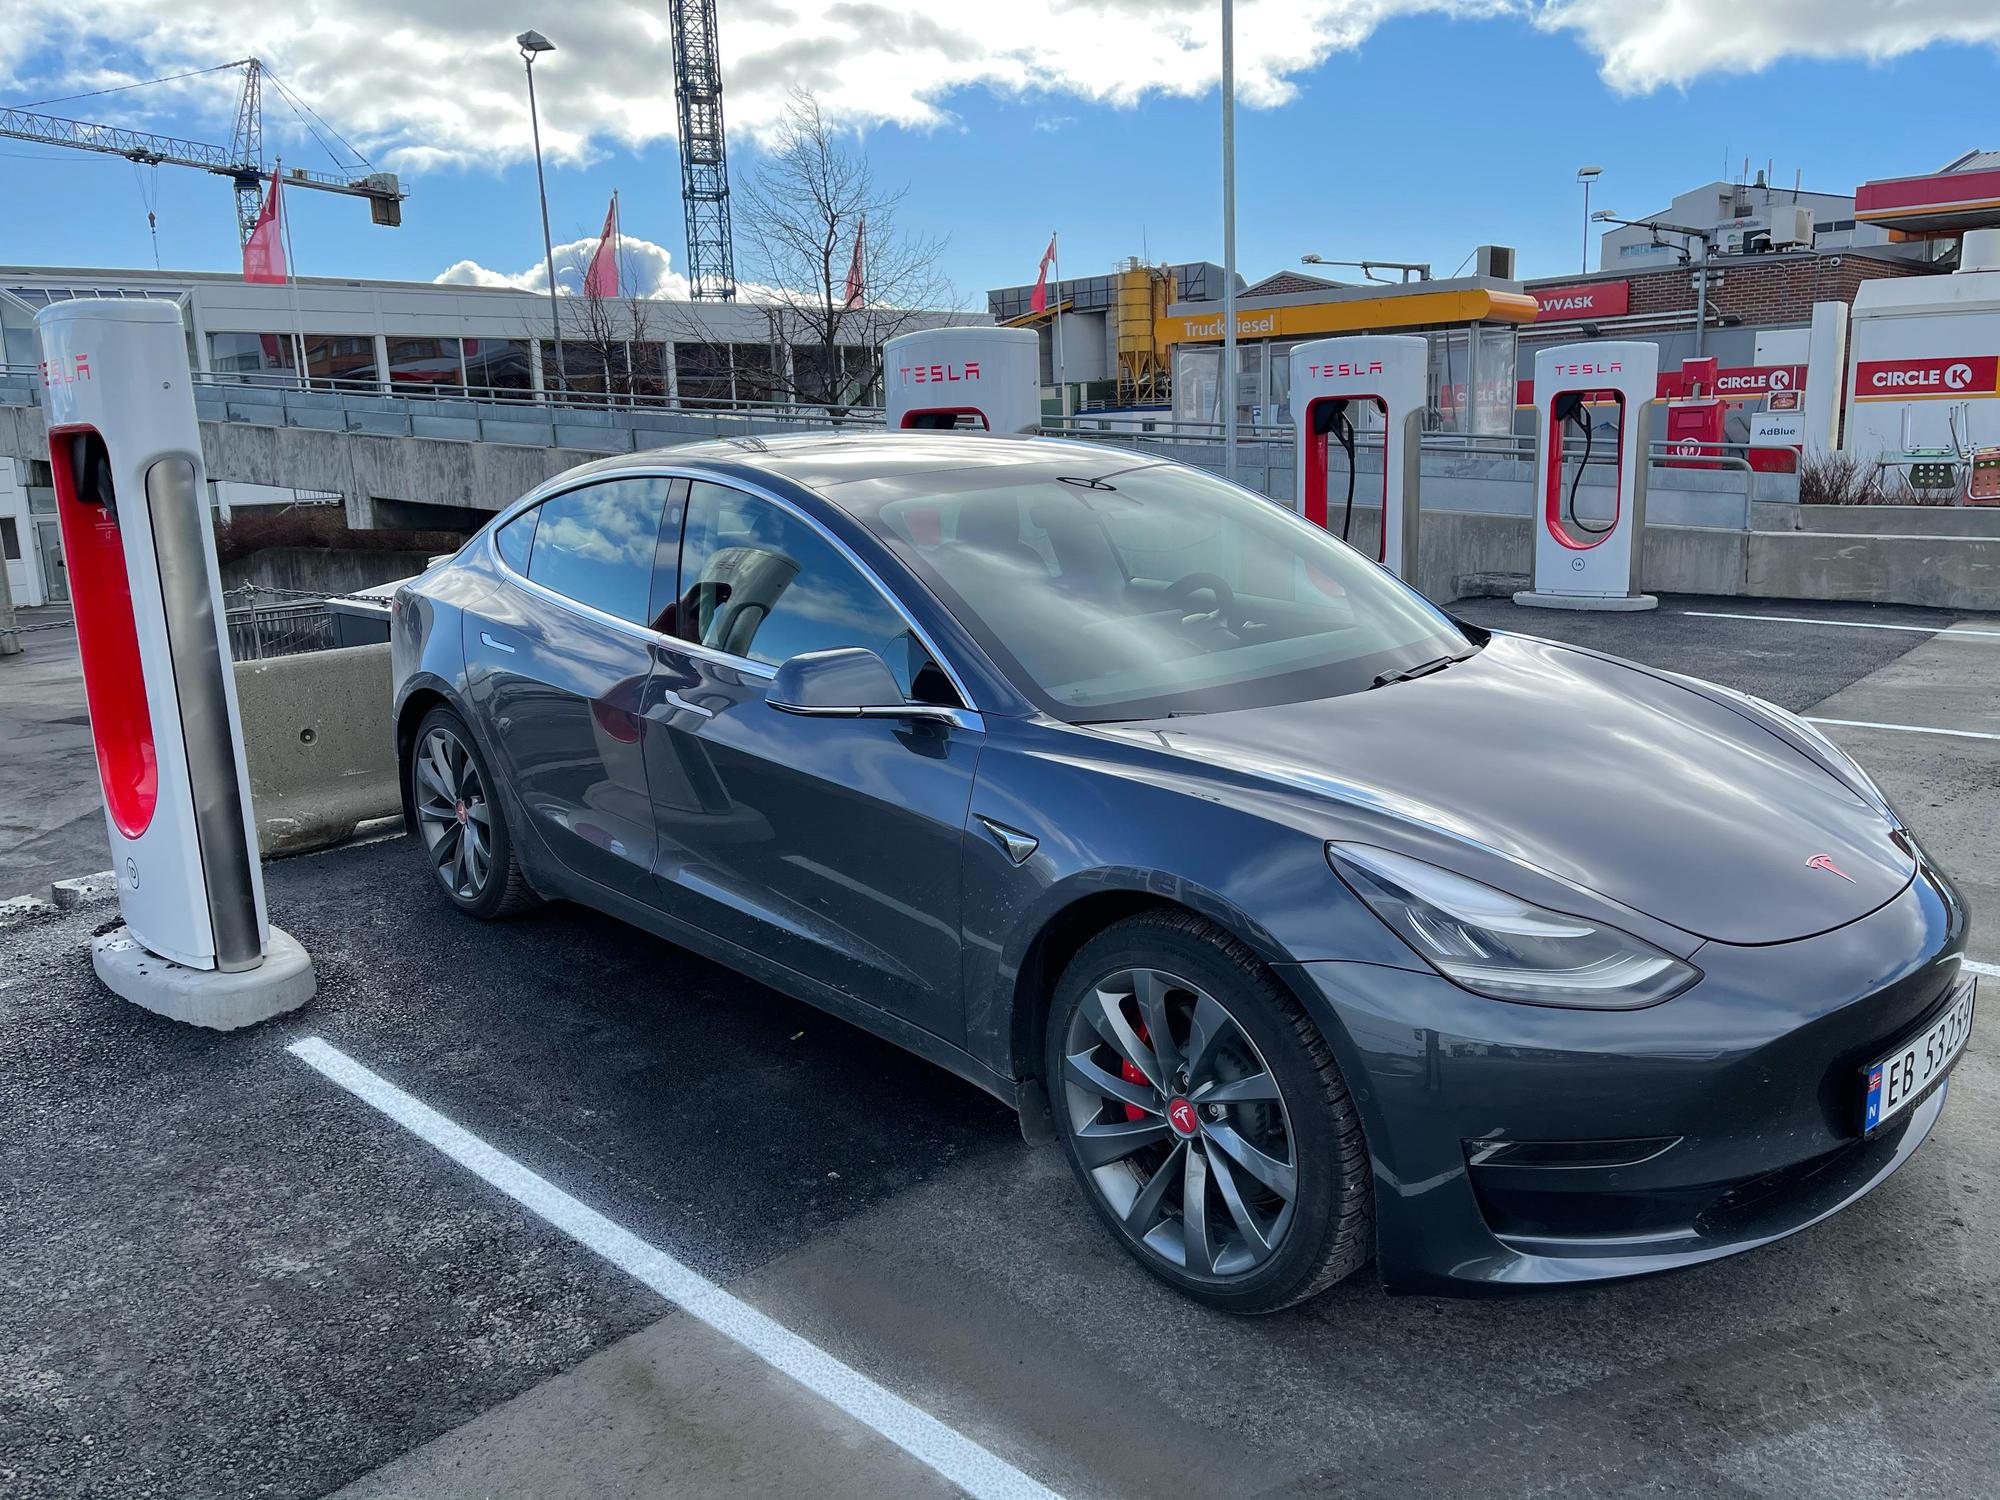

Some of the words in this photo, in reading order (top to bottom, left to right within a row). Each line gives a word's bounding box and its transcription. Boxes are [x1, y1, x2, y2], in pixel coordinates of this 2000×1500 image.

[1184, 313, 1274, 336] Truckiesel
[900, 362, 980, 385] TESLA
[1309, 362, 1382, 378] TESLA
[1555, 363, 1621, 375] TESLA
[1872, 370, 1940, 387] CIRCLE
[1946, 365, 1971, 388] K
[1717, 375, 1767, 389] CIRCLE
[1771, 371, 1788, 389] K
[1760, 428, 1796, 436] AdBlue
[1888, 1050, 1915, 1108] EB
[1923, 993, 1971, 1080] 53259
[1868, 1103, 1877, 1120] N
